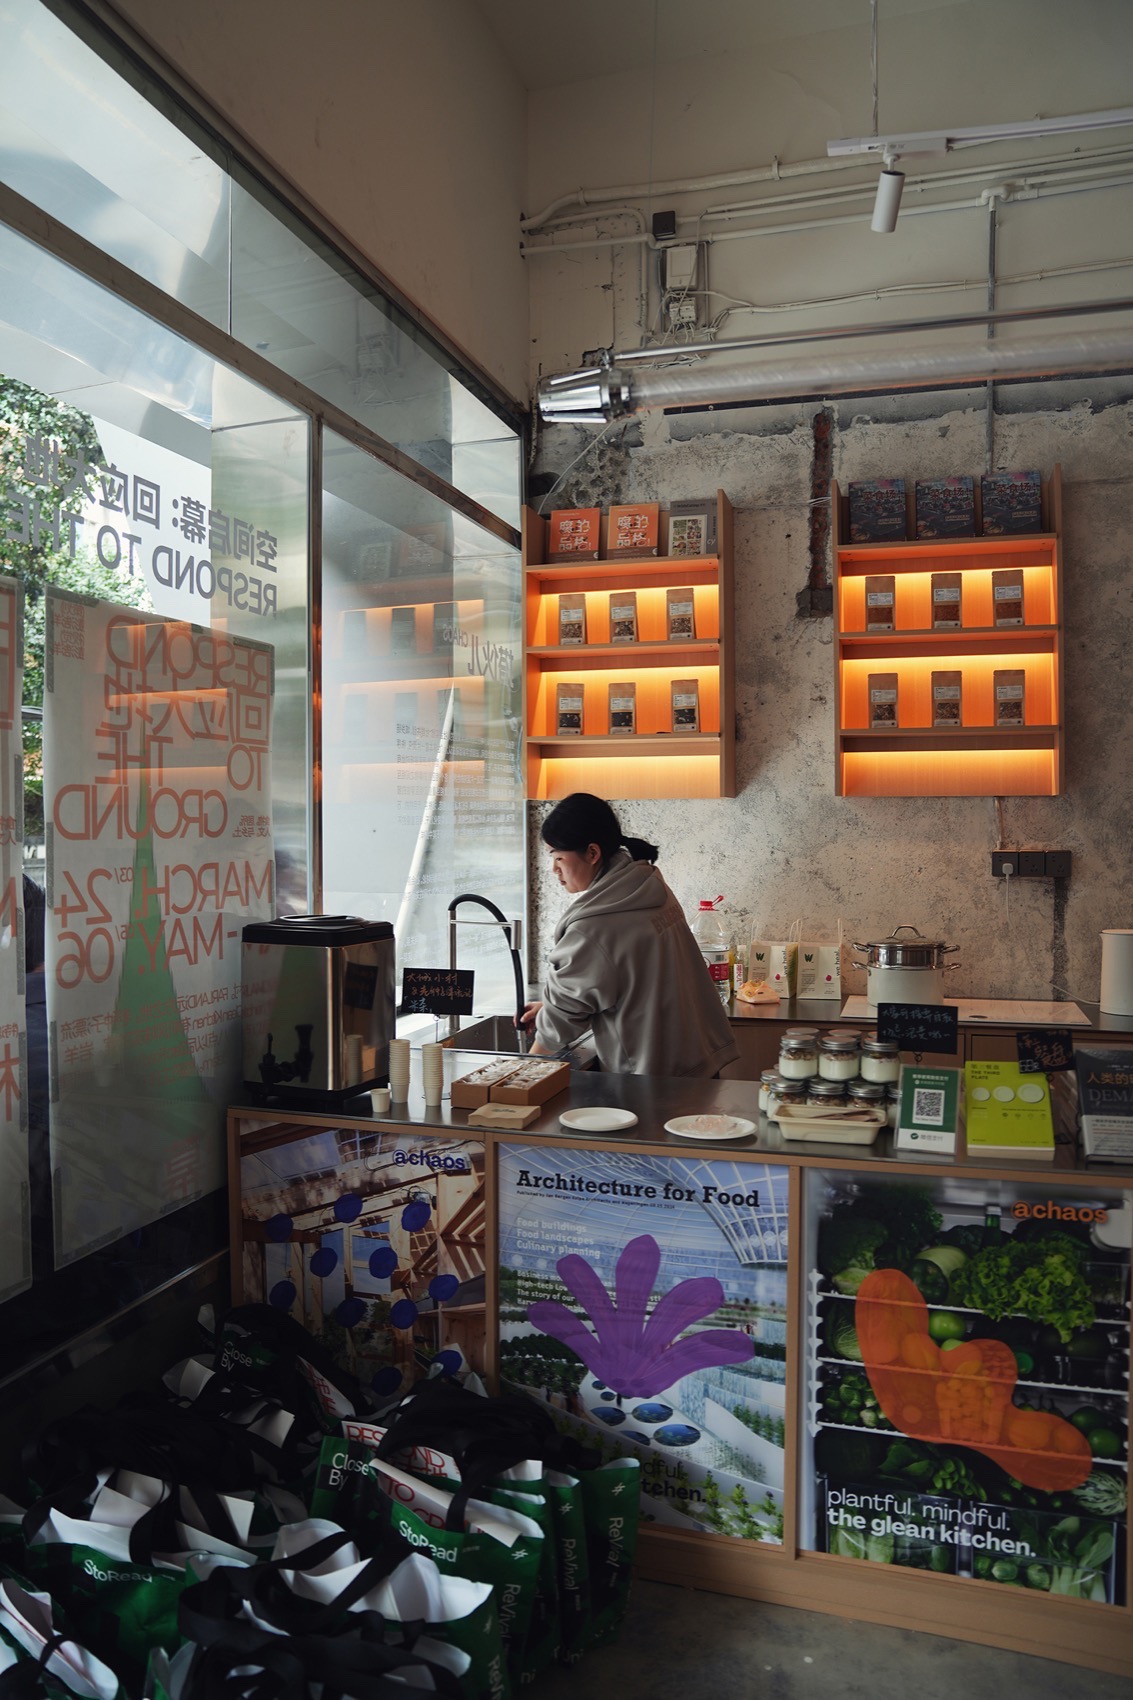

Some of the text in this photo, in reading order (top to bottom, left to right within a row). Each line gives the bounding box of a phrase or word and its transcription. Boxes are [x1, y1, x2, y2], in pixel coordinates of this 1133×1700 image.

[1087, 1072, 1133, 1086] 人类的
[516, 1170, 760, 1208] Architecture for Food
[516, 1217, 588, 1234] Food buildings
[516, 1229, 594, 1246] Food landscapes
[516, 1240, 601, 1259] Culinary planning
[517, 1289, 530, 1297] The
[531, 1291, 551, 1301] story
[561, 1294, 575, 1302] our
[223, 1340, 253, 1368] Close
[332, 1452, 369, 1476] Close
[328, 1469, 349, 1491] By
[382, 1476, 415, 1502] TO
[827, 1488, 1011, 1531] plantful. mindful.
[827, 1507, 1037, 1557] the glean kitchen.
